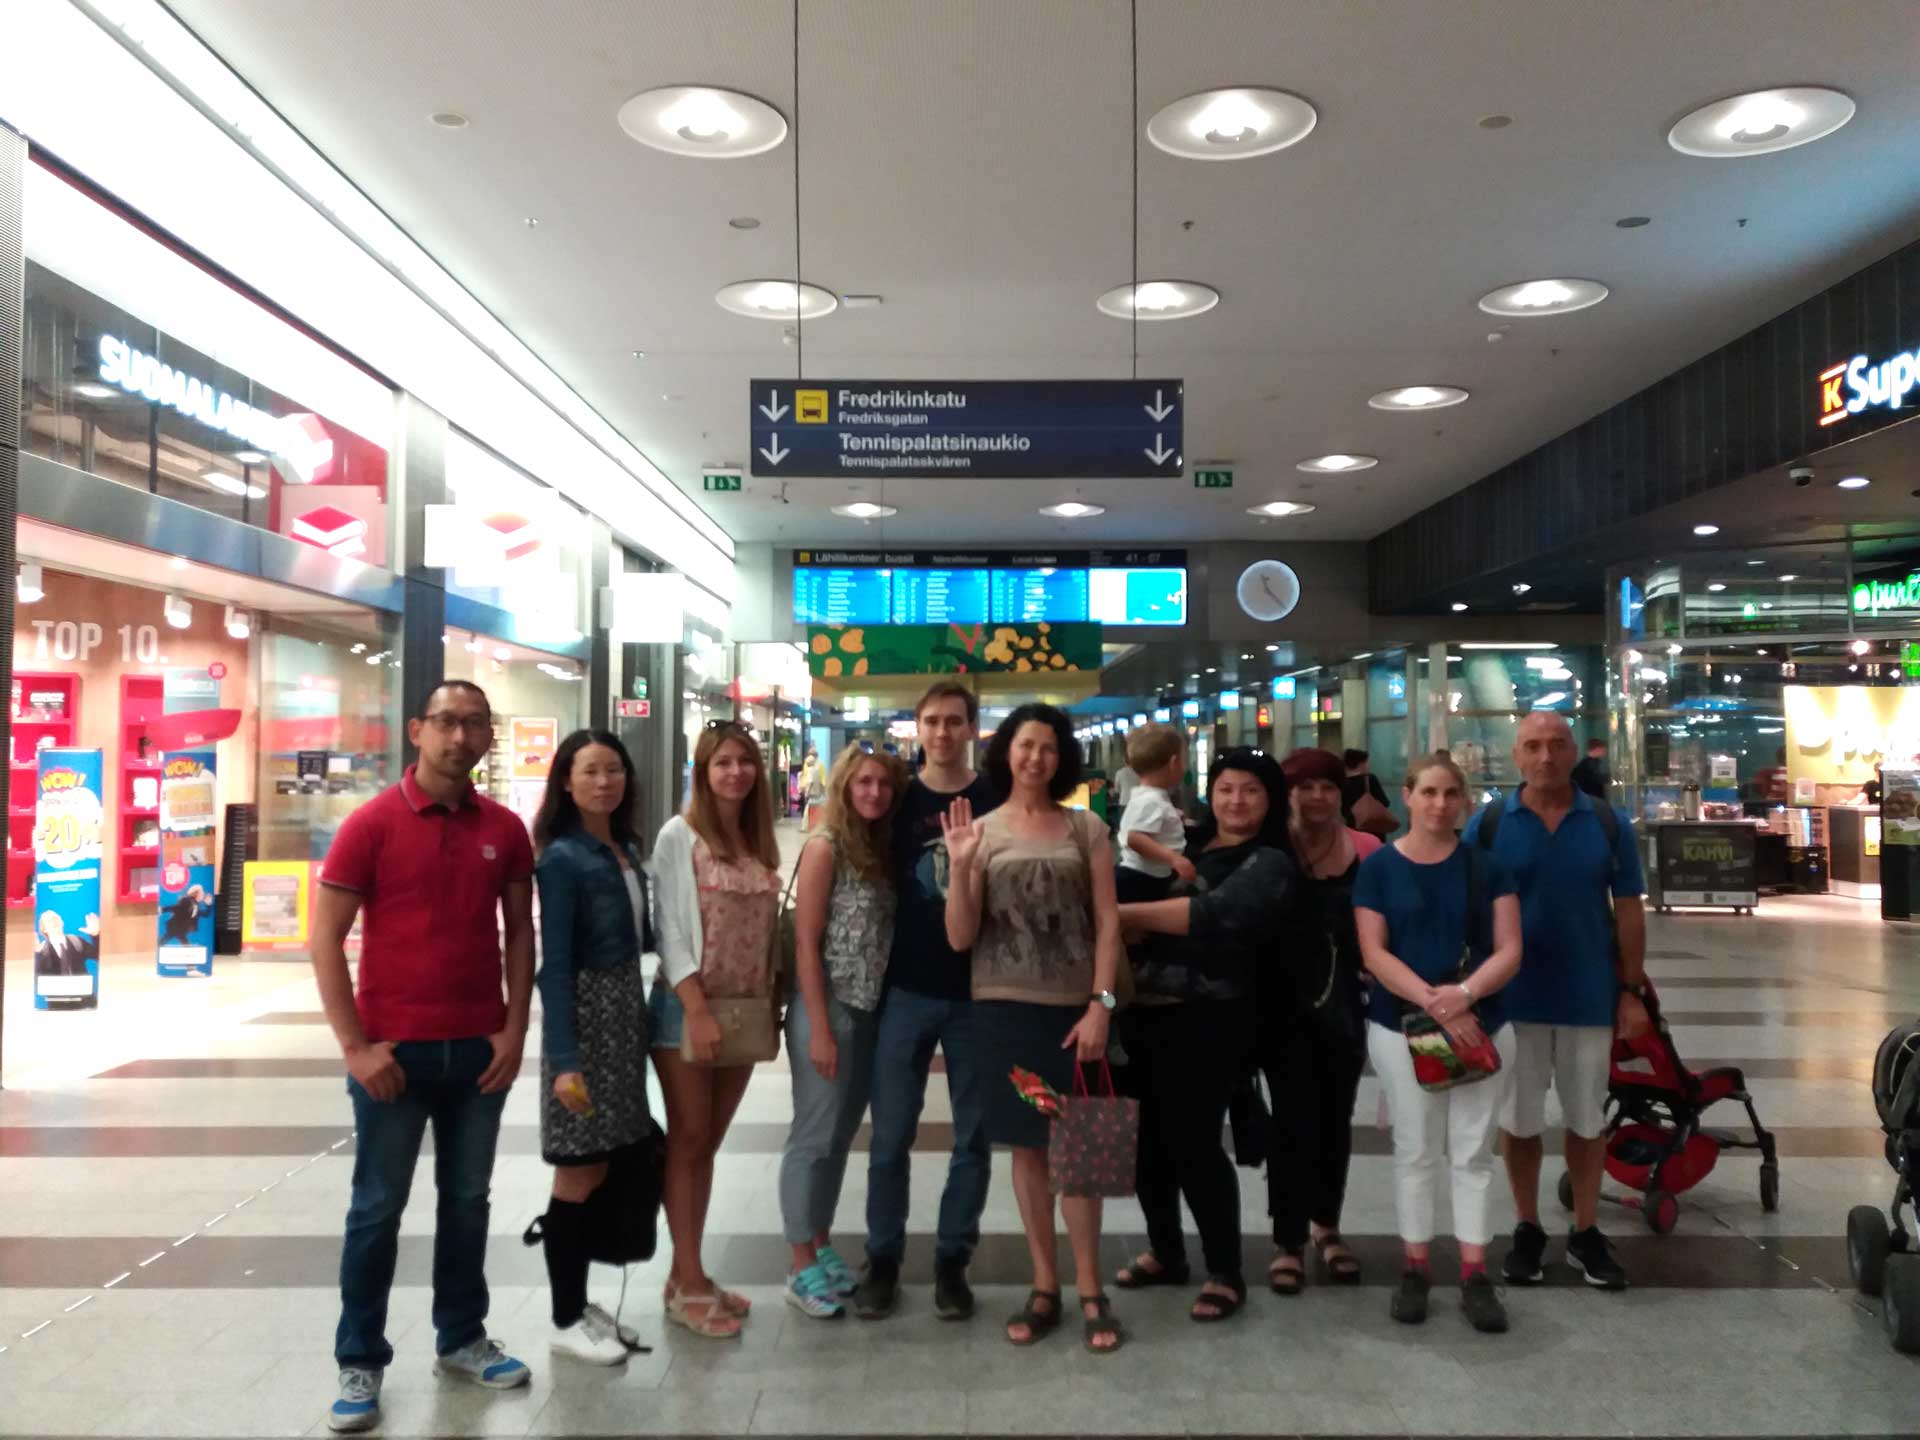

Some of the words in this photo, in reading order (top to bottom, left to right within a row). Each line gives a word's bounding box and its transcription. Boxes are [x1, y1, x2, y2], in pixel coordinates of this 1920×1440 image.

[838, 390, 967, 408] Fredrikinkatu
[838, 411, 929, 426] Fredriksgatan
[839, 433, 1031, 452] Tennispalatsinaukio
[839, 454, 971, 469] Tennispalatsskvären
[31, 620, 103, 661] TOP
[117, 624, 169, 663] 10.
[40, 769, 87, 792] WOW!
[1683, 846, 1734, 861] KAHVI
